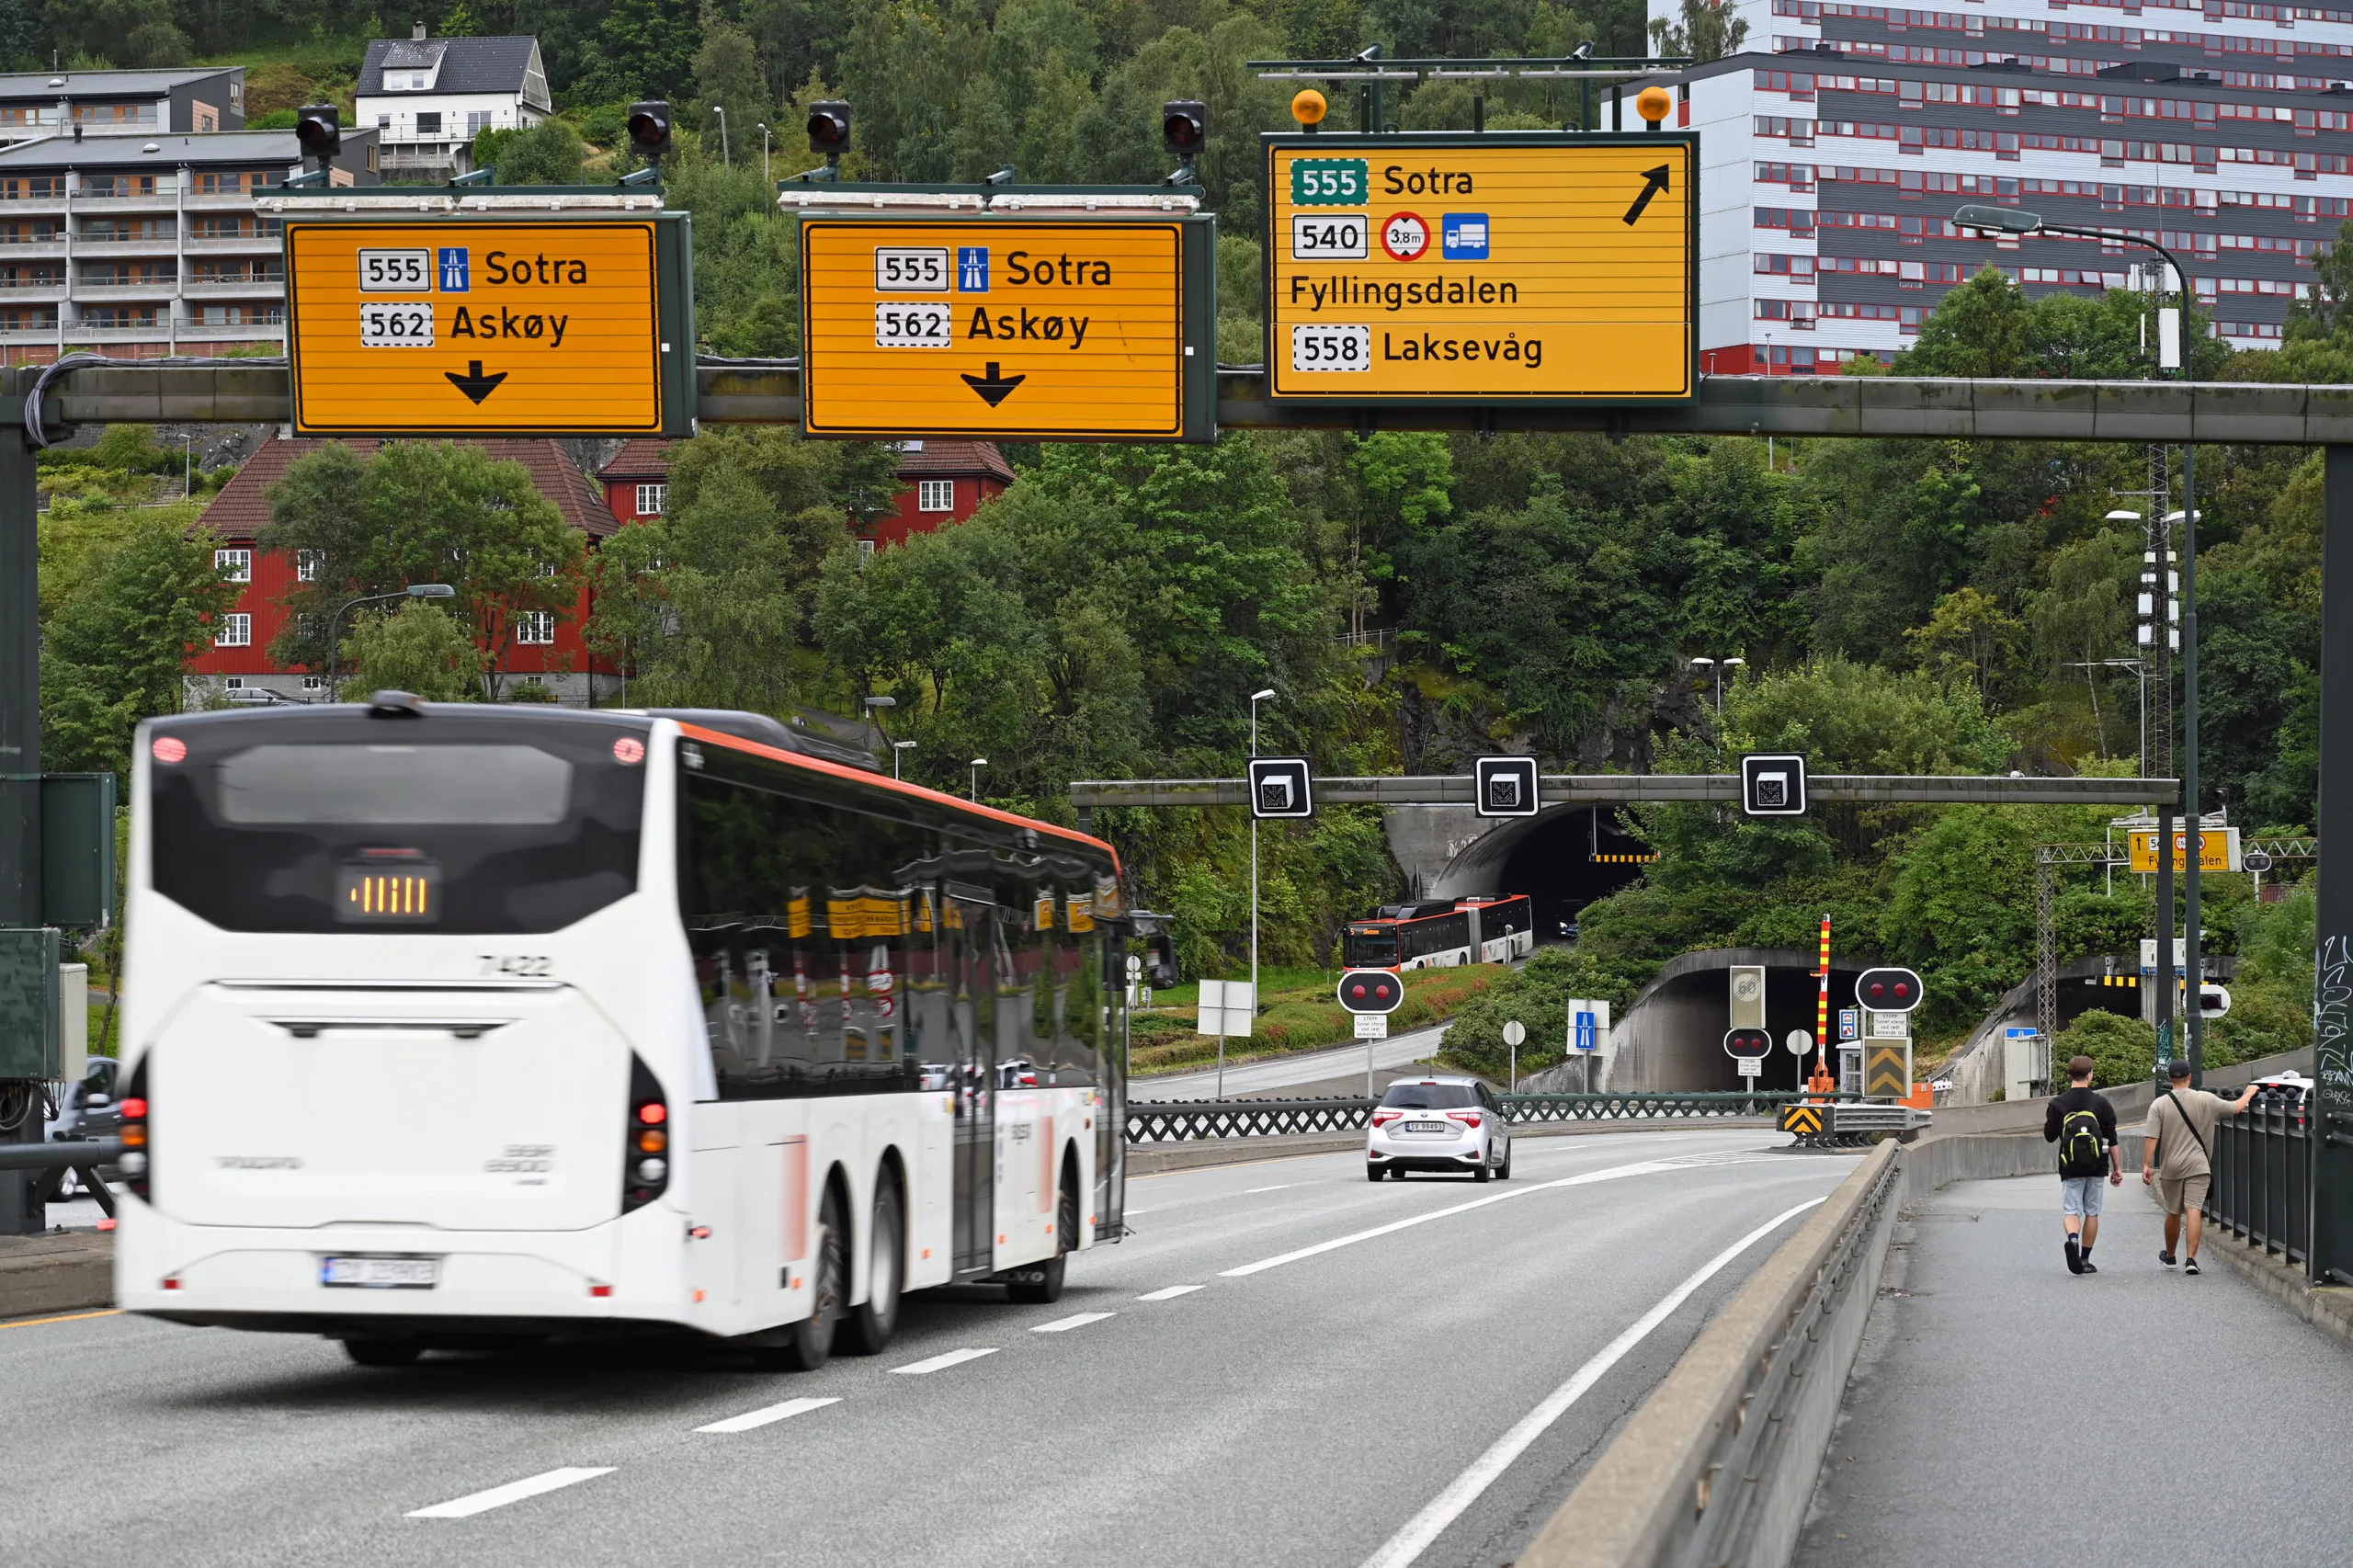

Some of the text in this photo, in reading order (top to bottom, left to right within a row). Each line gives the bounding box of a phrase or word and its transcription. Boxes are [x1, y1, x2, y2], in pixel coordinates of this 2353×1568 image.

[1302, 165, 1473, 196] 555 Sotra
[1302, 224, 1358, 250] 540
[368, 251, 587, 285] 555 Sotra
[885, 251, 1111, 286] 555 Sotra
[1291, 276, 1518, 312] Fyllingsdalen
[370, 306, 568, 348] 562 Askøy
[885, 306, 1089, 350] 562 Askøy
[1304, 332, 1542, 369] 558 Laksevåg
[2149, 856, 2221, 869] Fyngalen
[478, 955, 551, 976] 7422
